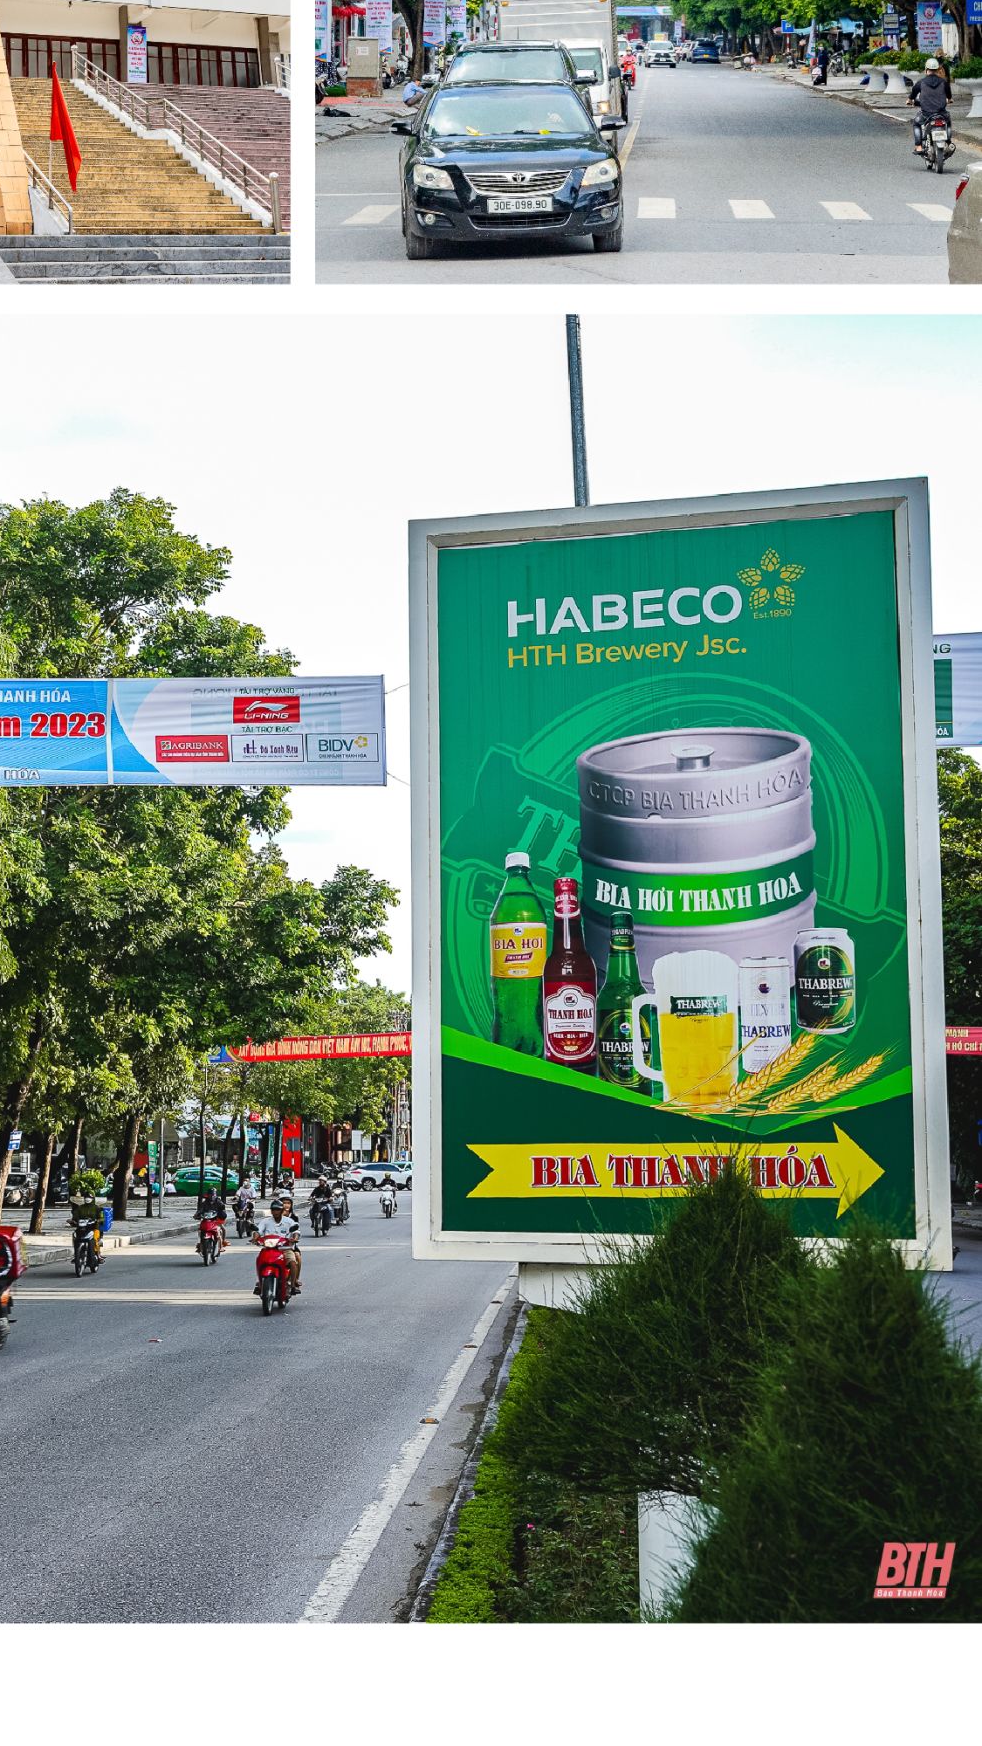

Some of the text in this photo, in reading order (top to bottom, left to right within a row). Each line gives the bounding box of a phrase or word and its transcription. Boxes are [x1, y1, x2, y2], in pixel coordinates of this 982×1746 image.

[507, 584, 743, 638] HABECO
[753, 608, 792, 620] Est.1890
[508, 634, 747, 668] HTH Brewery Jsc.
[244, 711, 289, 720] LI-NING
[29, 712, 106, 738] 2023
[169, 741, 223, 751] AGRIBANK
[319, 739, 355, 752] BIDV
[589, 782, 635, 807] CTCP
[641, 791, 674, 810] BIA
[679, 783, 749, 811] THANH
[595, 871, 803, 912] BIA HƠI THANH HOA
[494, 937, 544, 950] BIA HƠI
[798, 978, 852, 990] THABREW
[676, 999, 723, 1010] THABREW
[548, 1008, 575, 1020] THANH
[741, 1025, 791, 1039] THABREW
[531, 1154, 601, 1188] BIA
[748, 1144, 836, 1189] HÓA
